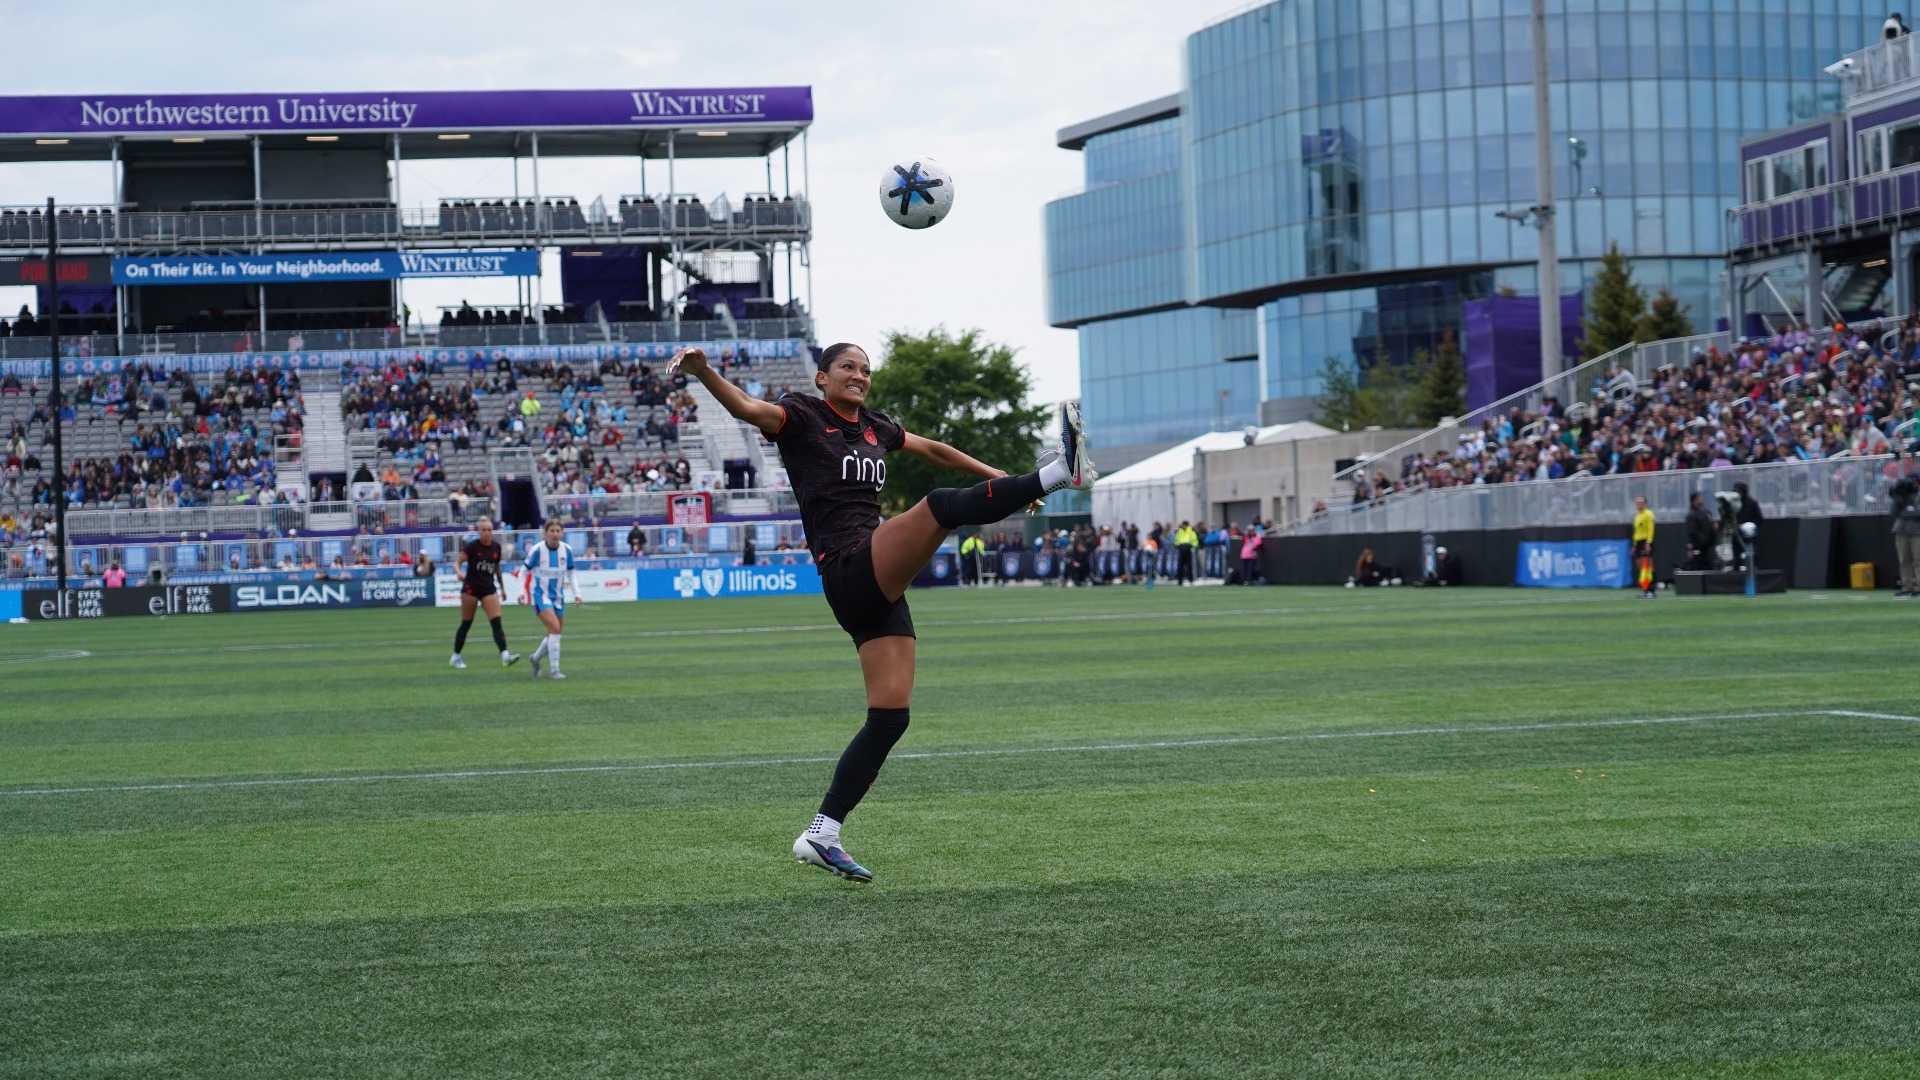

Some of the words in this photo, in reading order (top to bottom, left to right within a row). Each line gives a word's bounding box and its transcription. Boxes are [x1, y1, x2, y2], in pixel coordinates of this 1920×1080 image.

[80, 99, 271, 126] Northwestern
[277, 96, 418, 128] University
[631, 91, 766, 115] WINTRUST
[21, 261, 88, 282] PORLAND
[125, 263, 149, 278] On
[151, 262, 189, 277] Their
[193, 262, 219, 276] Kit.
[221, 262, 236, 276] In
[239, 260, 274, 276] Your
[276, 258, 384, 278] Neighborhood.
[400, 254, 505, 273] WINTRUST
[842, 449, 886, 492] ring
[476, 560, 496, 574] ring
[362, 580, 396, 590] SAVING
[397, 579, 427, 589] WATER
[729, 569, 797, 592] Illinois
[237, 583, 345, 607] SLOAN
[362, 590, 371, 600] IS
[373, 589, 395, 600] OUR
